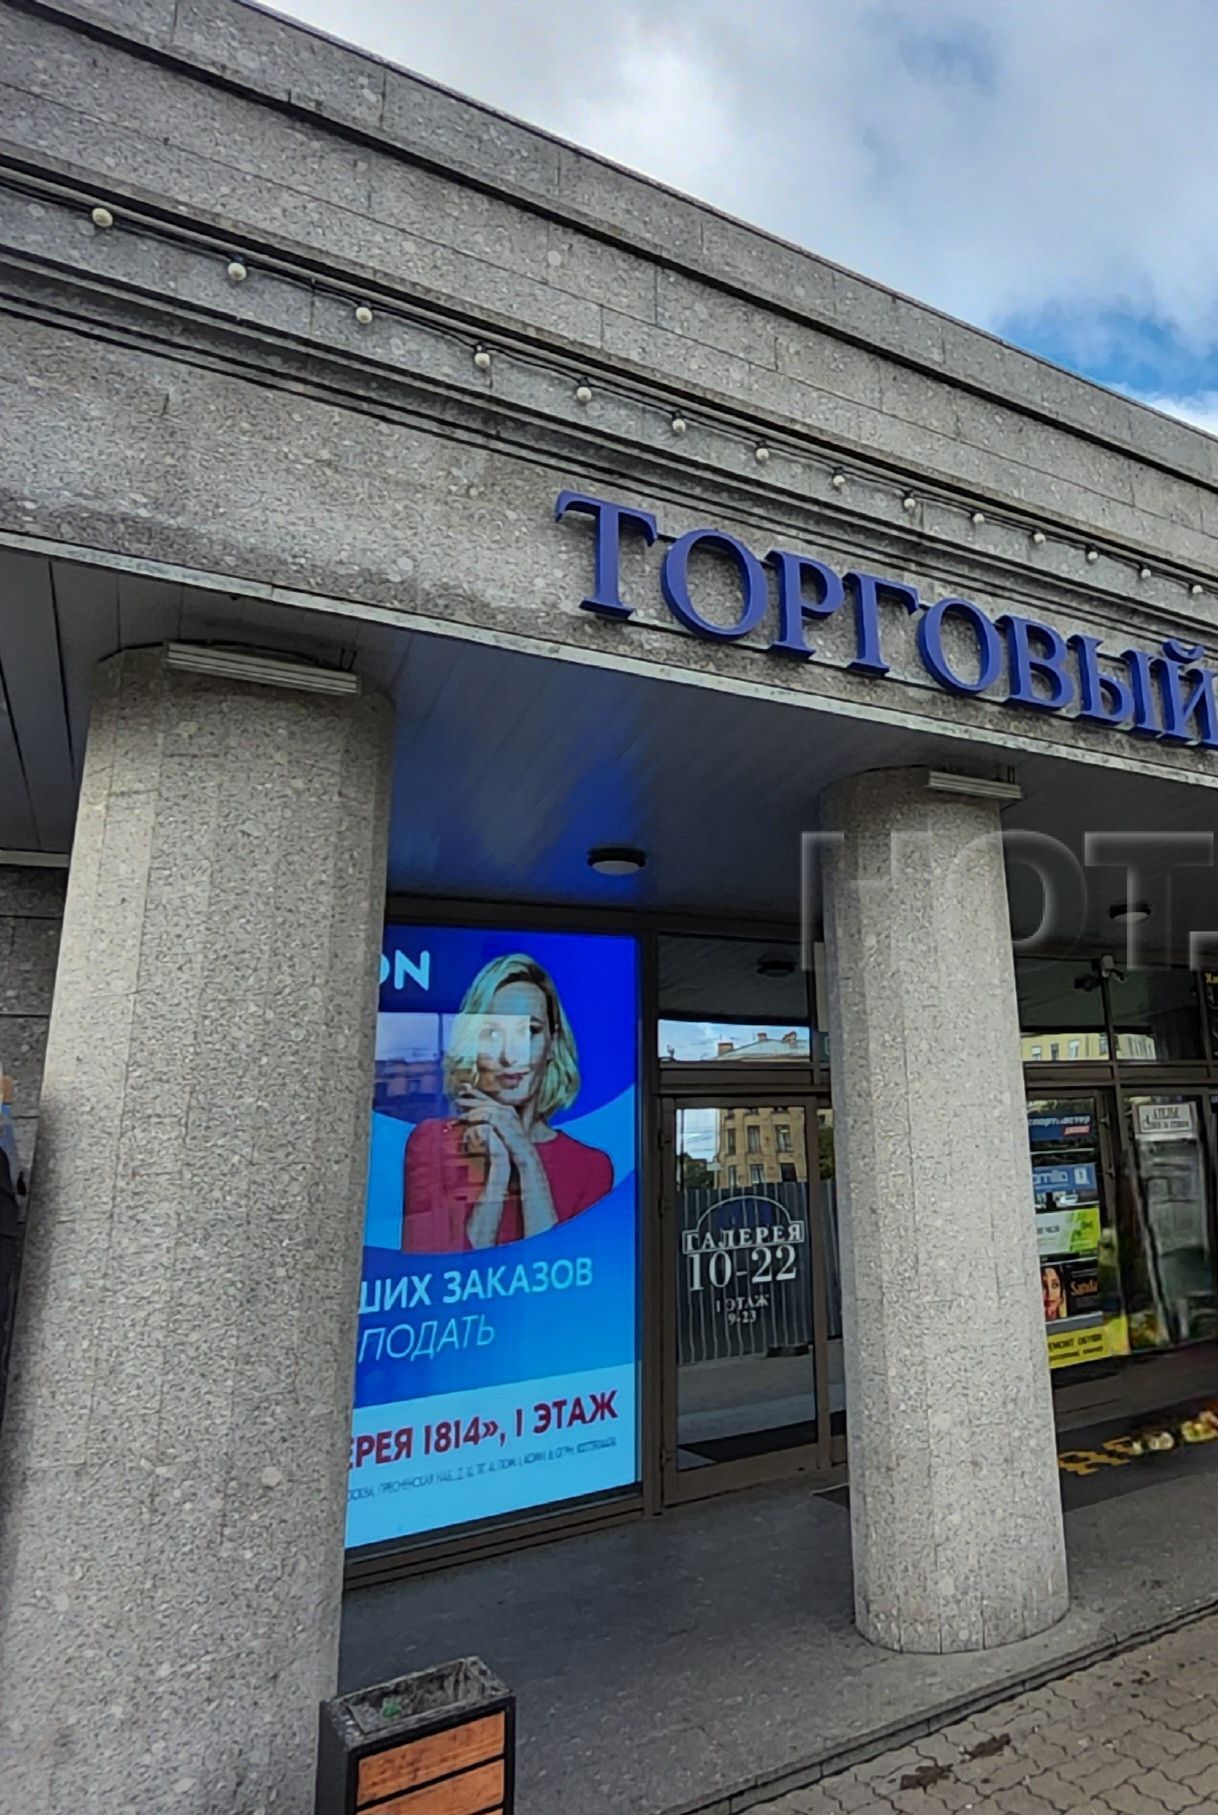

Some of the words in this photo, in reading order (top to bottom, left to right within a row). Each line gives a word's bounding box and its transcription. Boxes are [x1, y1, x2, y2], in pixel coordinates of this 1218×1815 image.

[686, 1224, 802, 1251] ГАЛЕРЕЯ
[442, 1257, 594, 1304] ЗАКАЗОВ
[688, 1244, 797, 1292] 10-22
[357, 1314, 496, 1363] ПОДАТЬ
[532, 1389, 618, 1434] ЭТАЖ
